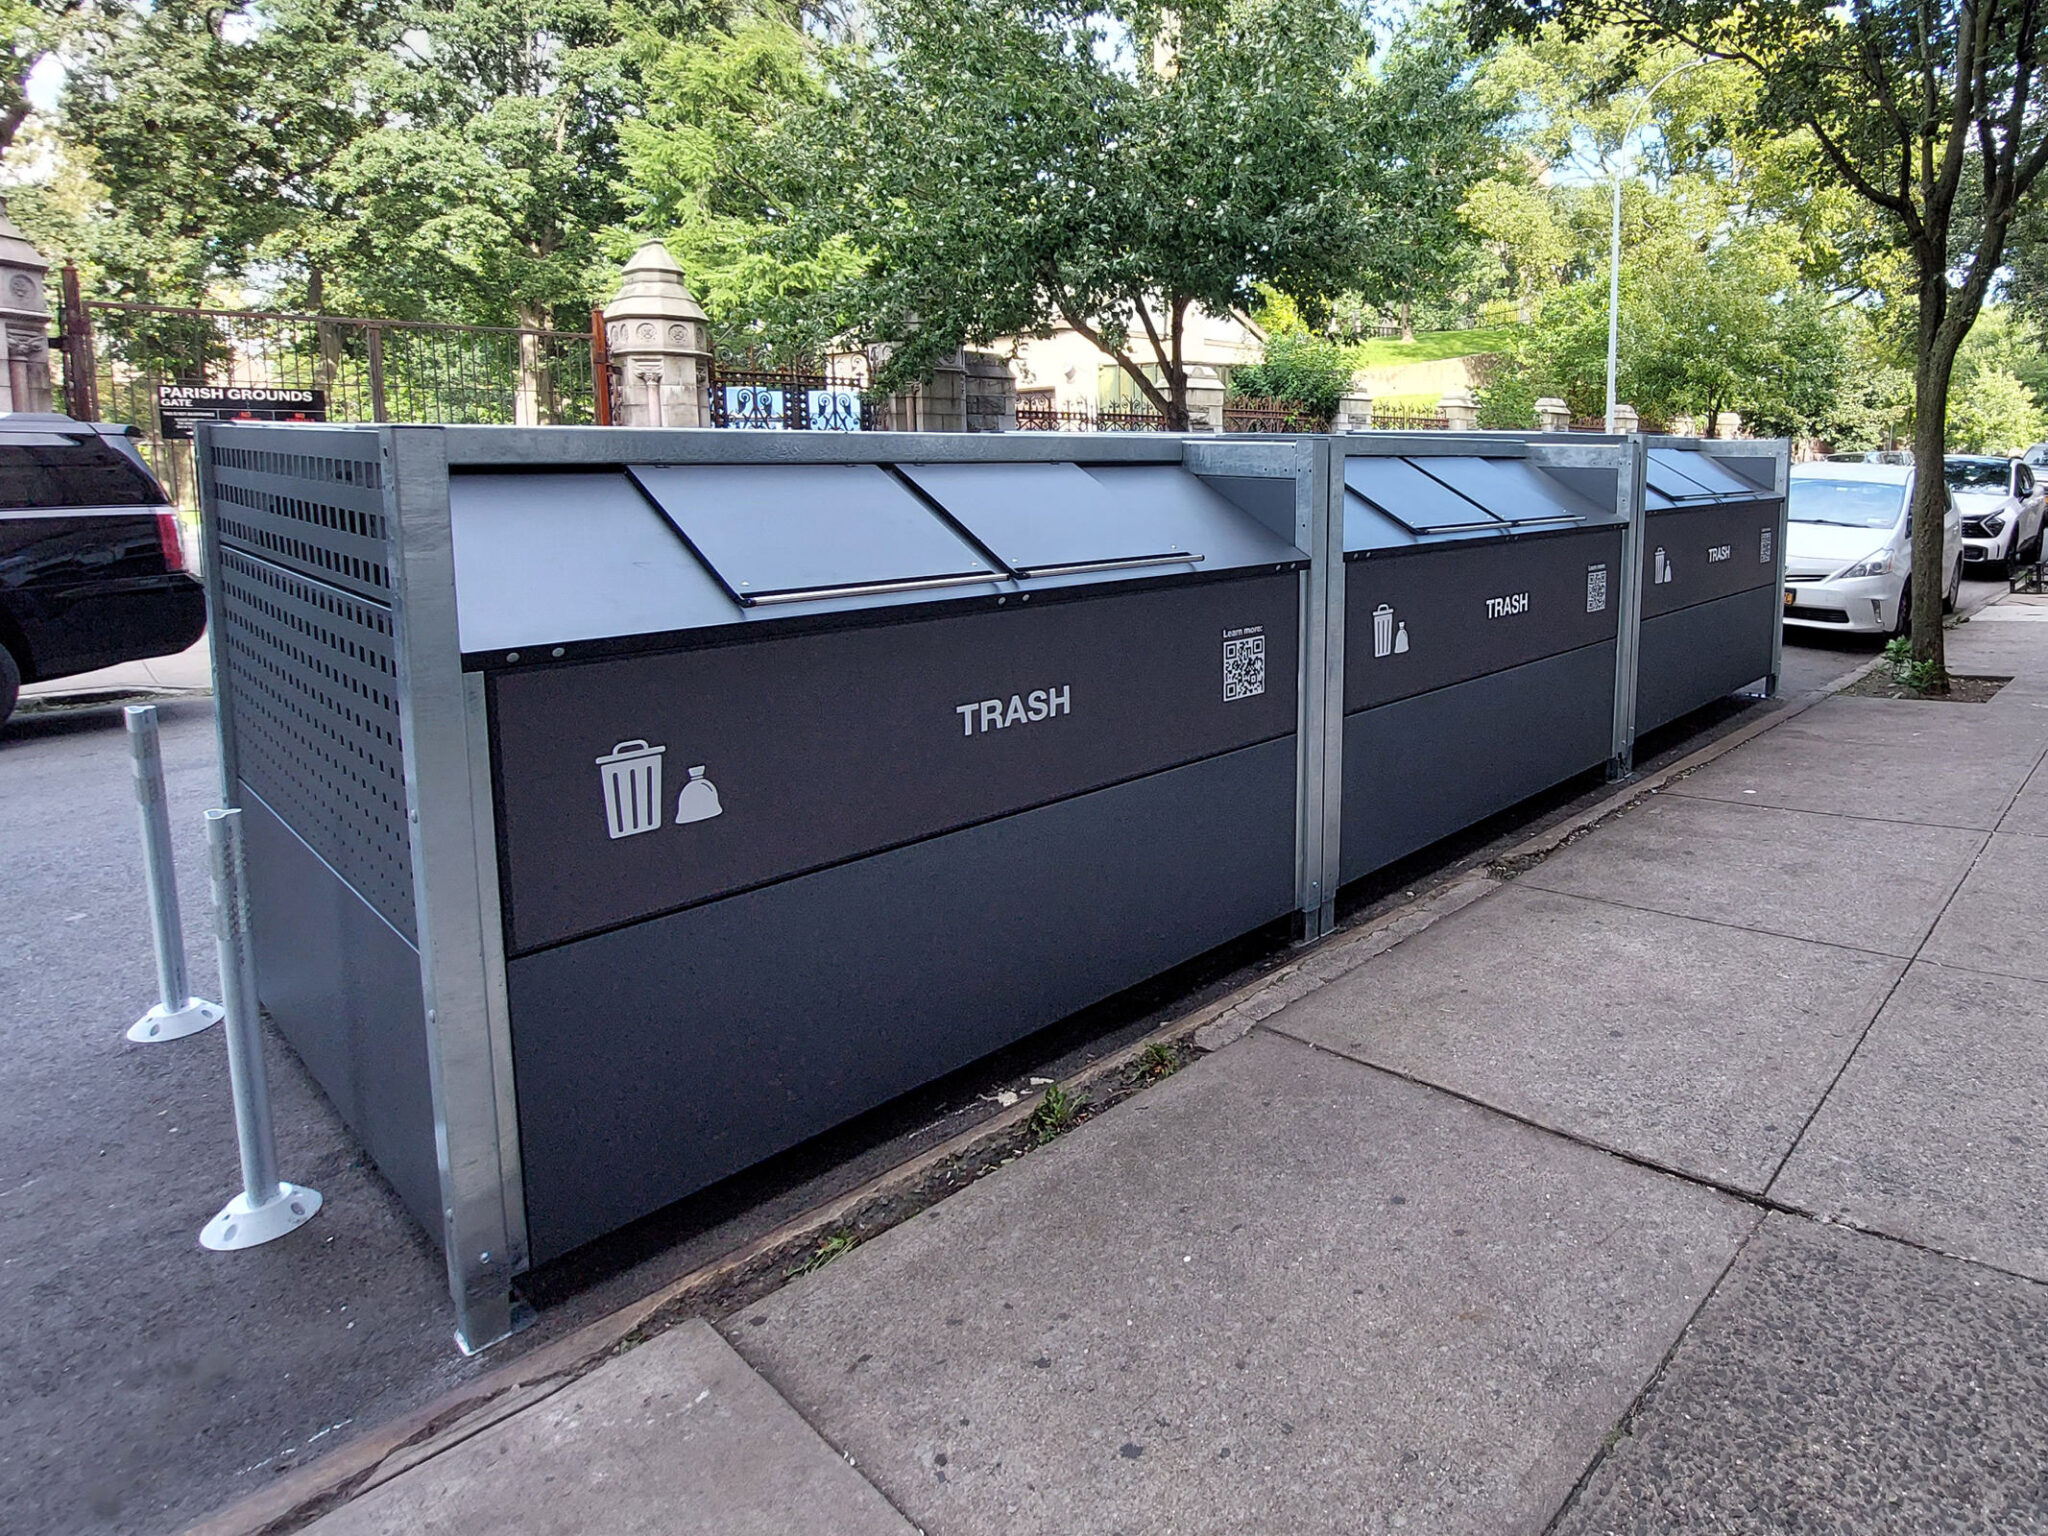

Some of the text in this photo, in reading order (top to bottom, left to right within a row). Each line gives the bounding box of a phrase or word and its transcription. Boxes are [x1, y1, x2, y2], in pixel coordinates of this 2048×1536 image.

[160, 386, 313, 402] PARISH GROUNDS
[160, 398, 193, 407] GATE
[1708, 545, 1731, 563] TRASH
[1486, 592, 1528, 619] TRASH
[1223, 628, 1243, 638] Learn
[956, 685, 1070, 736] TRASH
